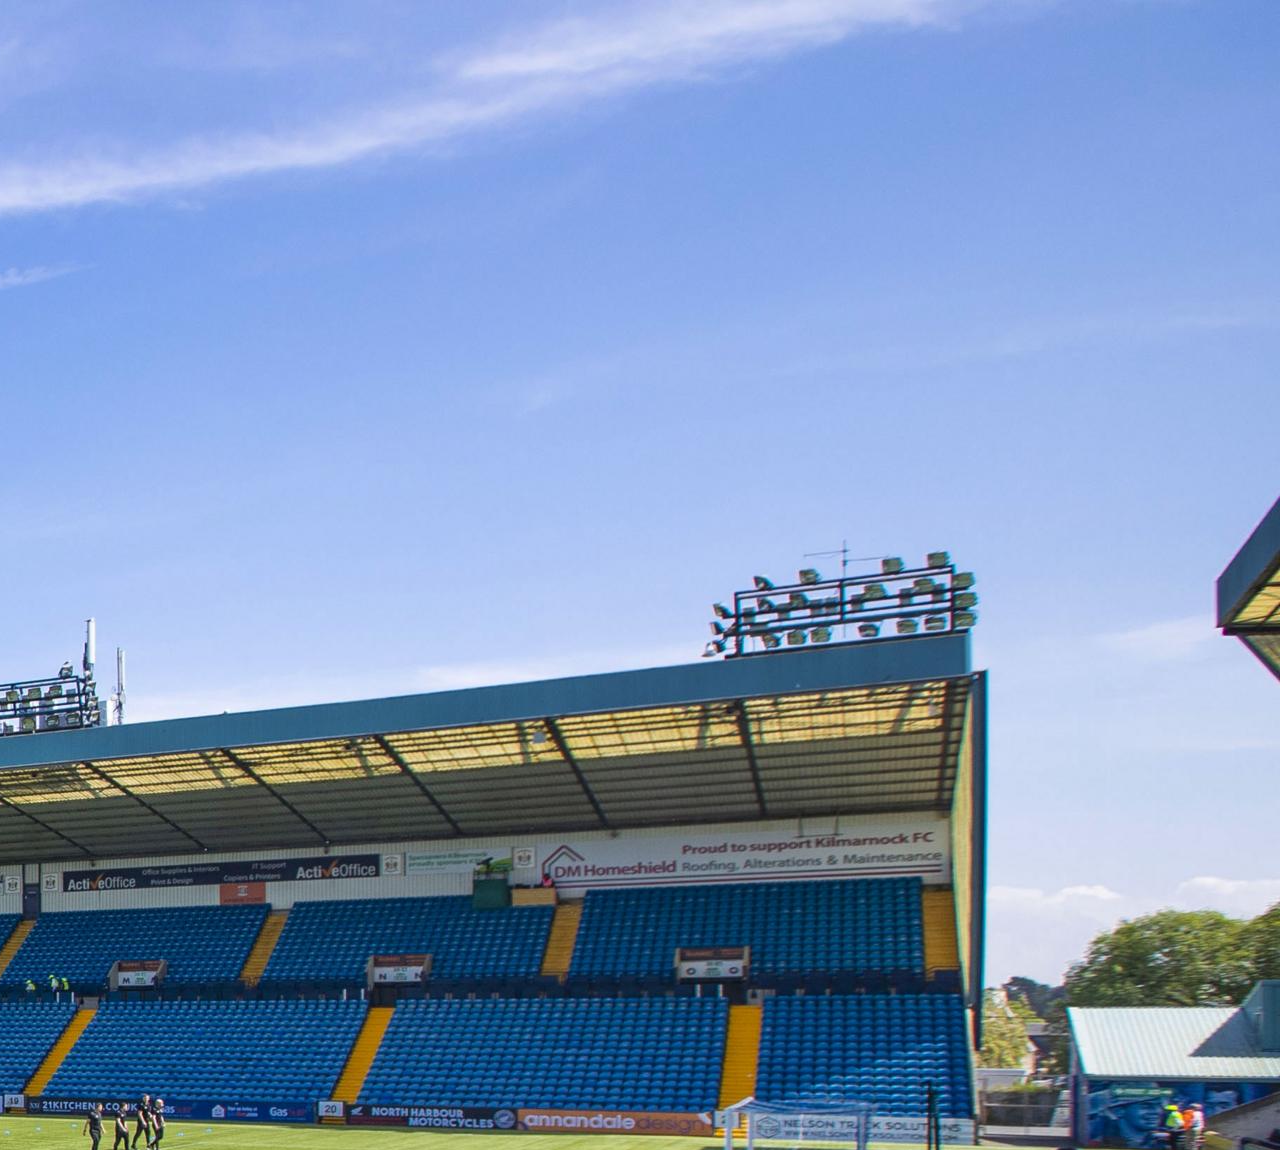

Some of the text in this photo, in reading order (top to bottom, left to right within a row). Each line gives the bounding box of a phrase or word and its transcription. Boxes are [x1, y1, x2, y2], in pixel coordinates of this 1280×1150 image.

[682, 832, 935, 854] Proud to support Kilmarnock FC
[260, 862, 286, 870] Support
[744, 854, 822, 869] Alterations
[826, 854, 839, 865] &
[843, 851, 943, 864] Maintenance
[161, 867, 187, 875] Supplies
[554, 860, 677, 878] DM Homeshield
[324, 1104, 336, 1114] 20
[371, 1107, 463, 1118] NORTH HARBOUR
[409, 1118, 494, 1129] MOTORCYCLES
[524, 1114, 705, 1133] annandale design
[783, 1119, 835, 1129] NELSON
[886, 1122, 961, 1133] SOLUTNS
